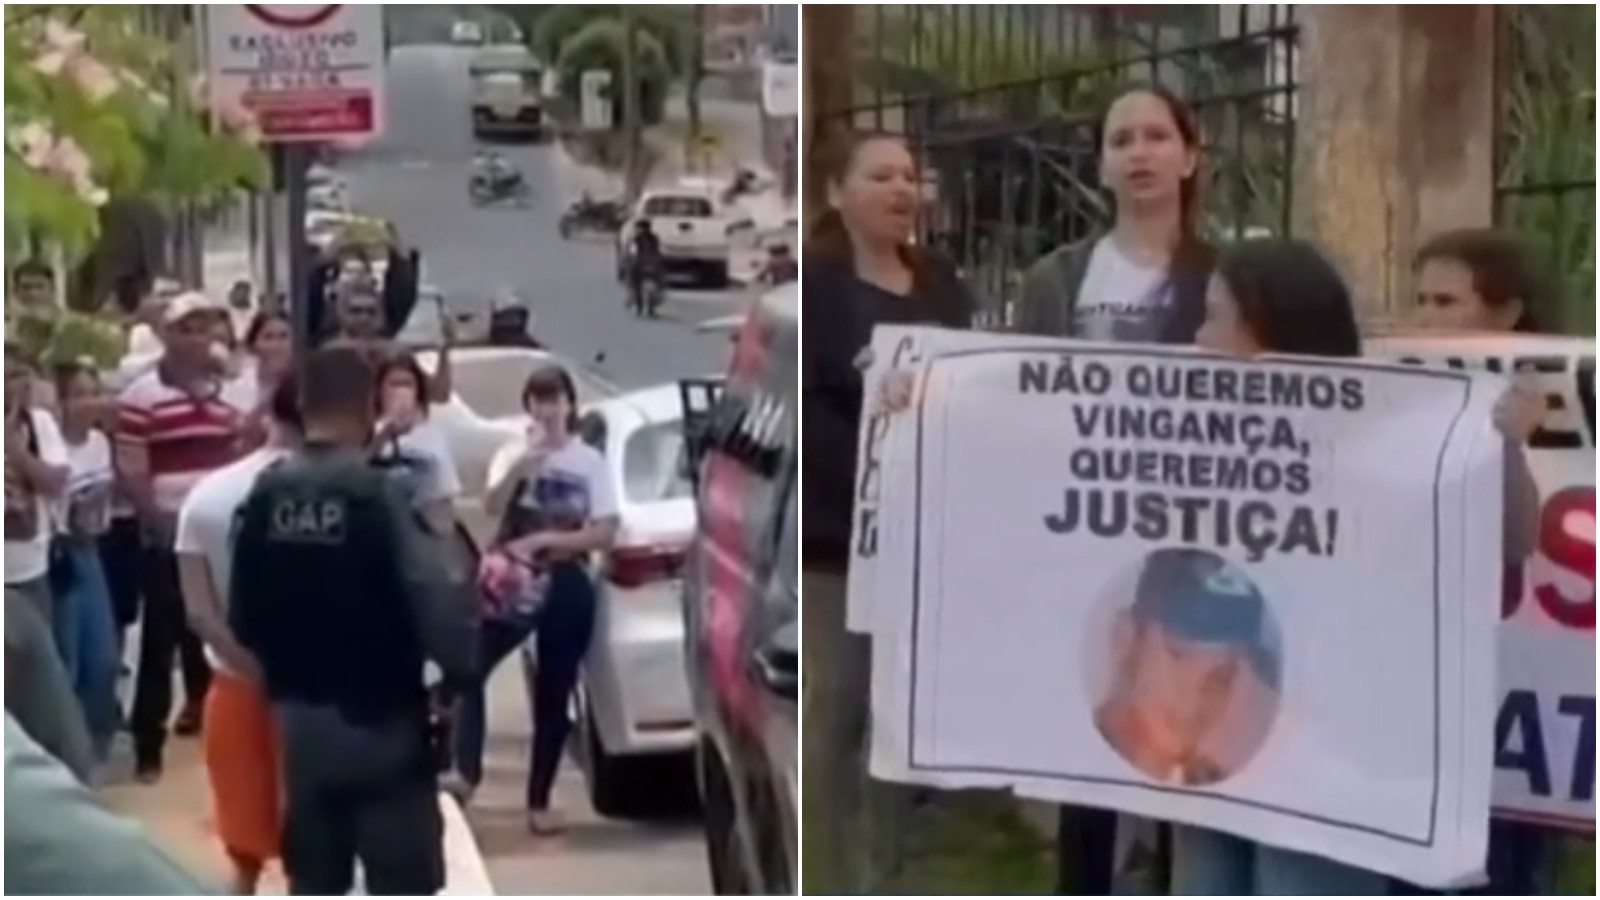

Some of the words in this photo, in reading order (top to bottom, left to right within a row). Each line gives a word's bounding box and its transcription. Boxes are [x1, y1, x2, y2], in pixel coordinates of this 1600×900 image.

[1019, 356, 1112, 394] NÃO
[1127, 364, 1365, 411] QUEREMOS
[1072, 403, 1311, 457] VINGANÇA,
[1069, 448, 1311, 494] QUEREMOS
[1043, 488, 1339, 563] JUSTIÇA!
